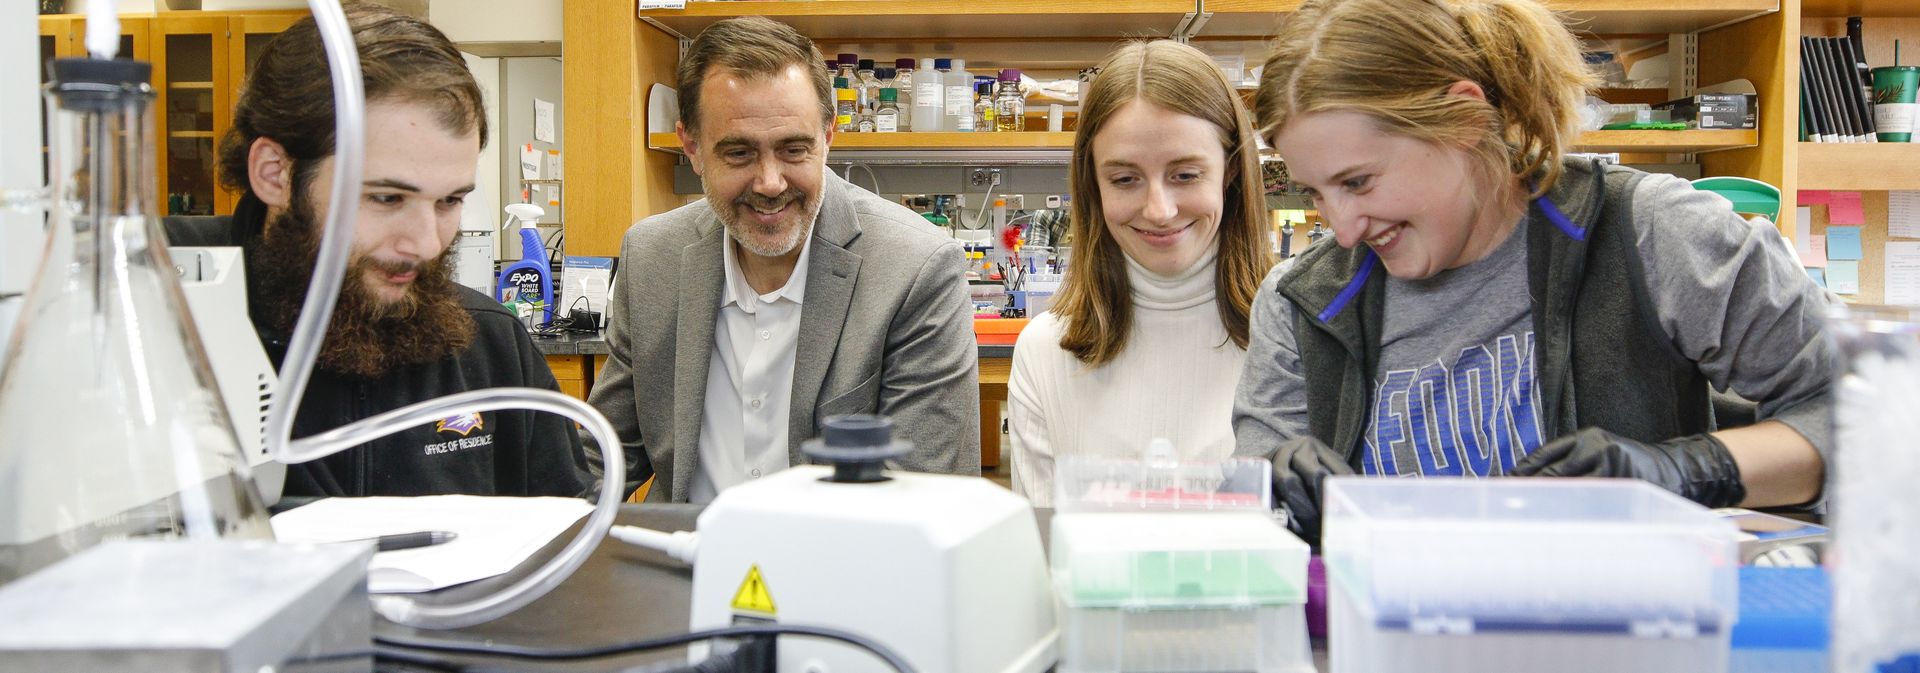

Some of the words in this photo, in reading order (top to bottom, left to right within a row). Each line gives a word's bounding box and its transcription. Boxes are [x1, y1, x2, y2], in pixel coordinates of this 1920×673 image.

[510, 273, 538, 285] EXPO
[424, 443, 448, 455] OFFICE
[448, 441, 458, 451] OF
[459, 434, 493, 449] RESIDENCE
